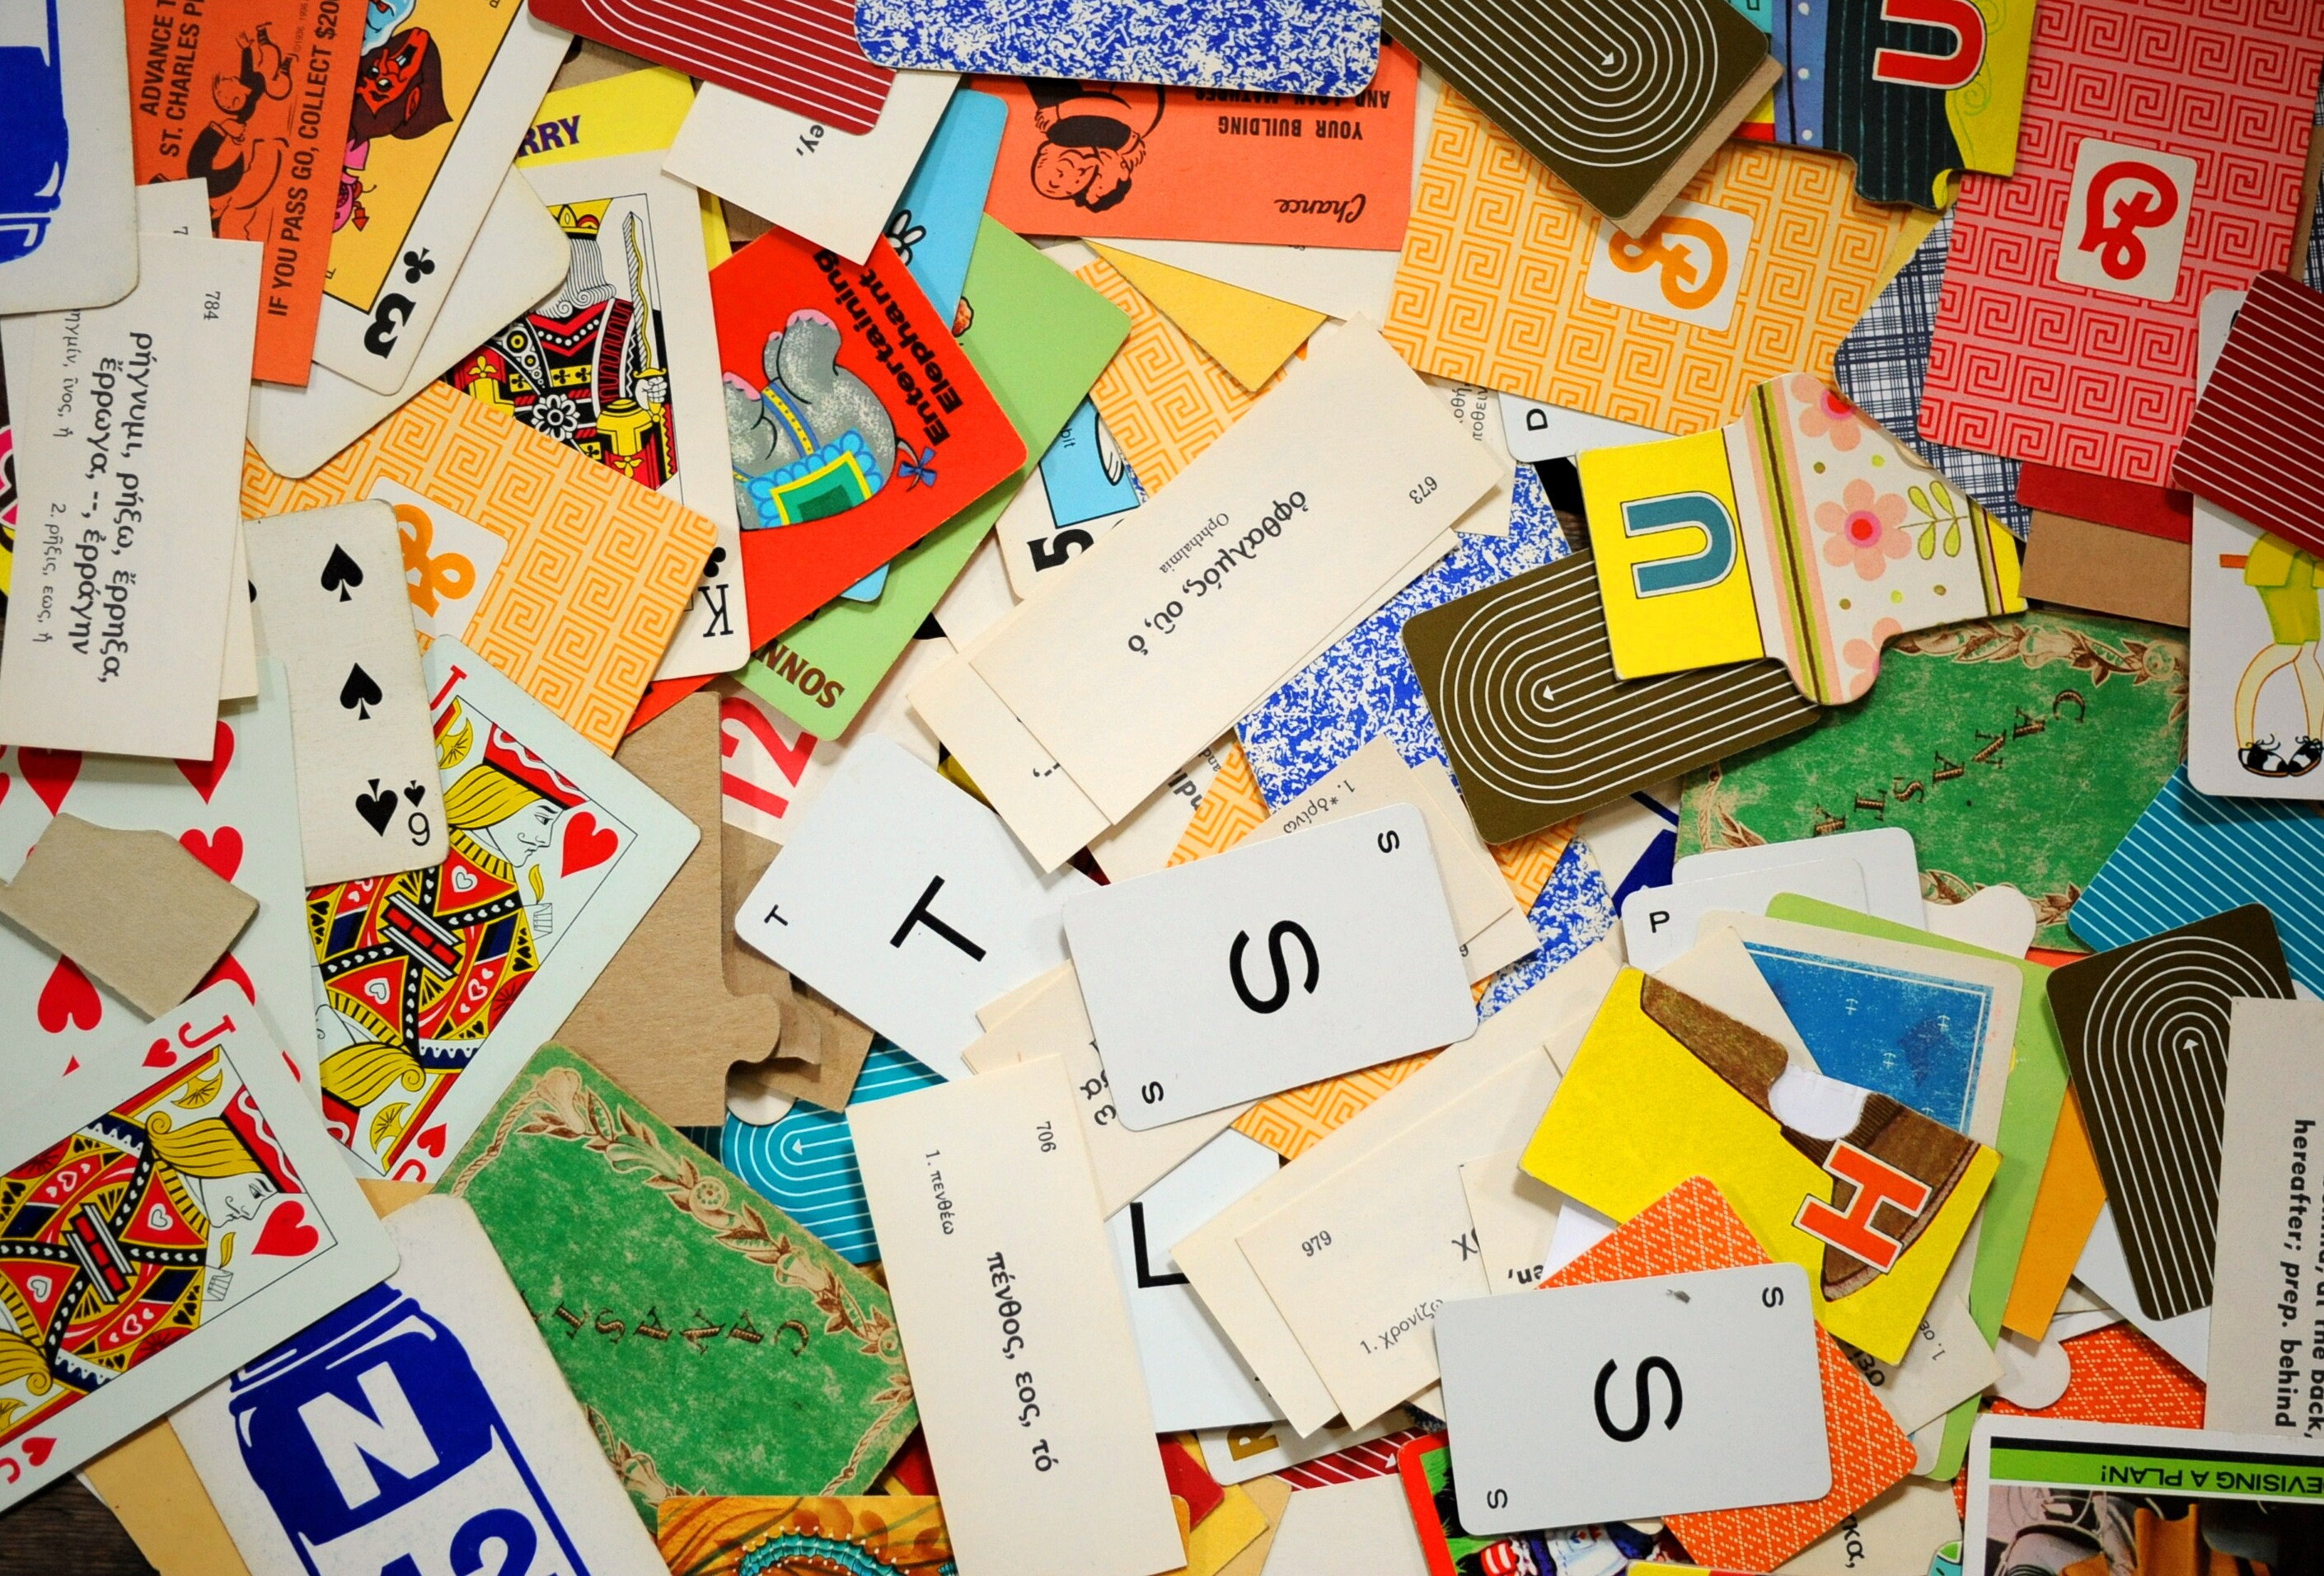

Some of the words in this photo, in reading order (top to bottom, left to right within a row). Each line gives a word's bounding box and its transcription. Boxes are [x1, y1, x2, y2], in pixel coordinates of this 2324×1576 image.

[183, 0, 204, 16] P
[315, 0, 339, 40] $20
[140, 15, 173, 116] ADVANCE
[166, 24, 199, 120] CHARLES
[298, 45, 330, 139] COLLECT
[160, 129, 182, 157] ST.
[1218, 116, 1301, 138] BUILDING
[1315, 120, 1363, 140] YOUR
[292, 148, 319, 180] GO,
[281, 187, 307, 242] PASS
[1274, 194, 1366, 223] Chance
[272, 248, 298, 288] YOU
[204, 292, 220, 320] 784
[268, 296, 288, 316] IF
[363, 293, 415, 359] 3
[58, 308, 83, 366] ηγμίν,
[813, 248, 950, 446] Entertaining
[859, 269, 963, 414] Elephant
[1060, 422, 1076, 448] bit
[1526, 409, 1548, 430] D
[1409, 476, 1436, 504] 673
[51, 504, 66, 517] 2.
[1027, 531, 1094, 572] 5
[1160, 514, 1229, 573] Ophthalmia
[1622, 490, 1738, 600] U
[699, 584, 734, 638] K
[751, 636, 846, 710] NNOS
[1814, 689, 2086, 834] CANASTA
[1378, 831, 1399, 853] S
[765, 905, 788, 926] T
[890, 875, 986, 961] T
[1650, 911, 1670, 933] P
[1230, 921, 1319, 1014] S
[177, 1014, 237, 1048] J
[1142, 1081, 1164, 1104] S
[1037, 1121, 1056, 1152] 706
[1792, 1137, 1933, 1273] H
[2284, 1120, 2313, 1250] hereafter;
[1302, 1231, 1331, 1256] 979
[1762, 1288, 1783, 1307] S
[2278, 1261, 2299, 1326] prep.
[521, 1290, 810, 1358] CANAST
[1595, 1357, 1682, 1442] S
[2275, 1339, 2302, 1427] behind
[297, 1360, 440, 1510] N
[2100, 1465, 2182, 1486] PLAN!
[2190, 1470, 2209, 1488] A
[2216, 1471, 2324, 1494] EVISING
[1488, 1489, 1507, 1508] S
